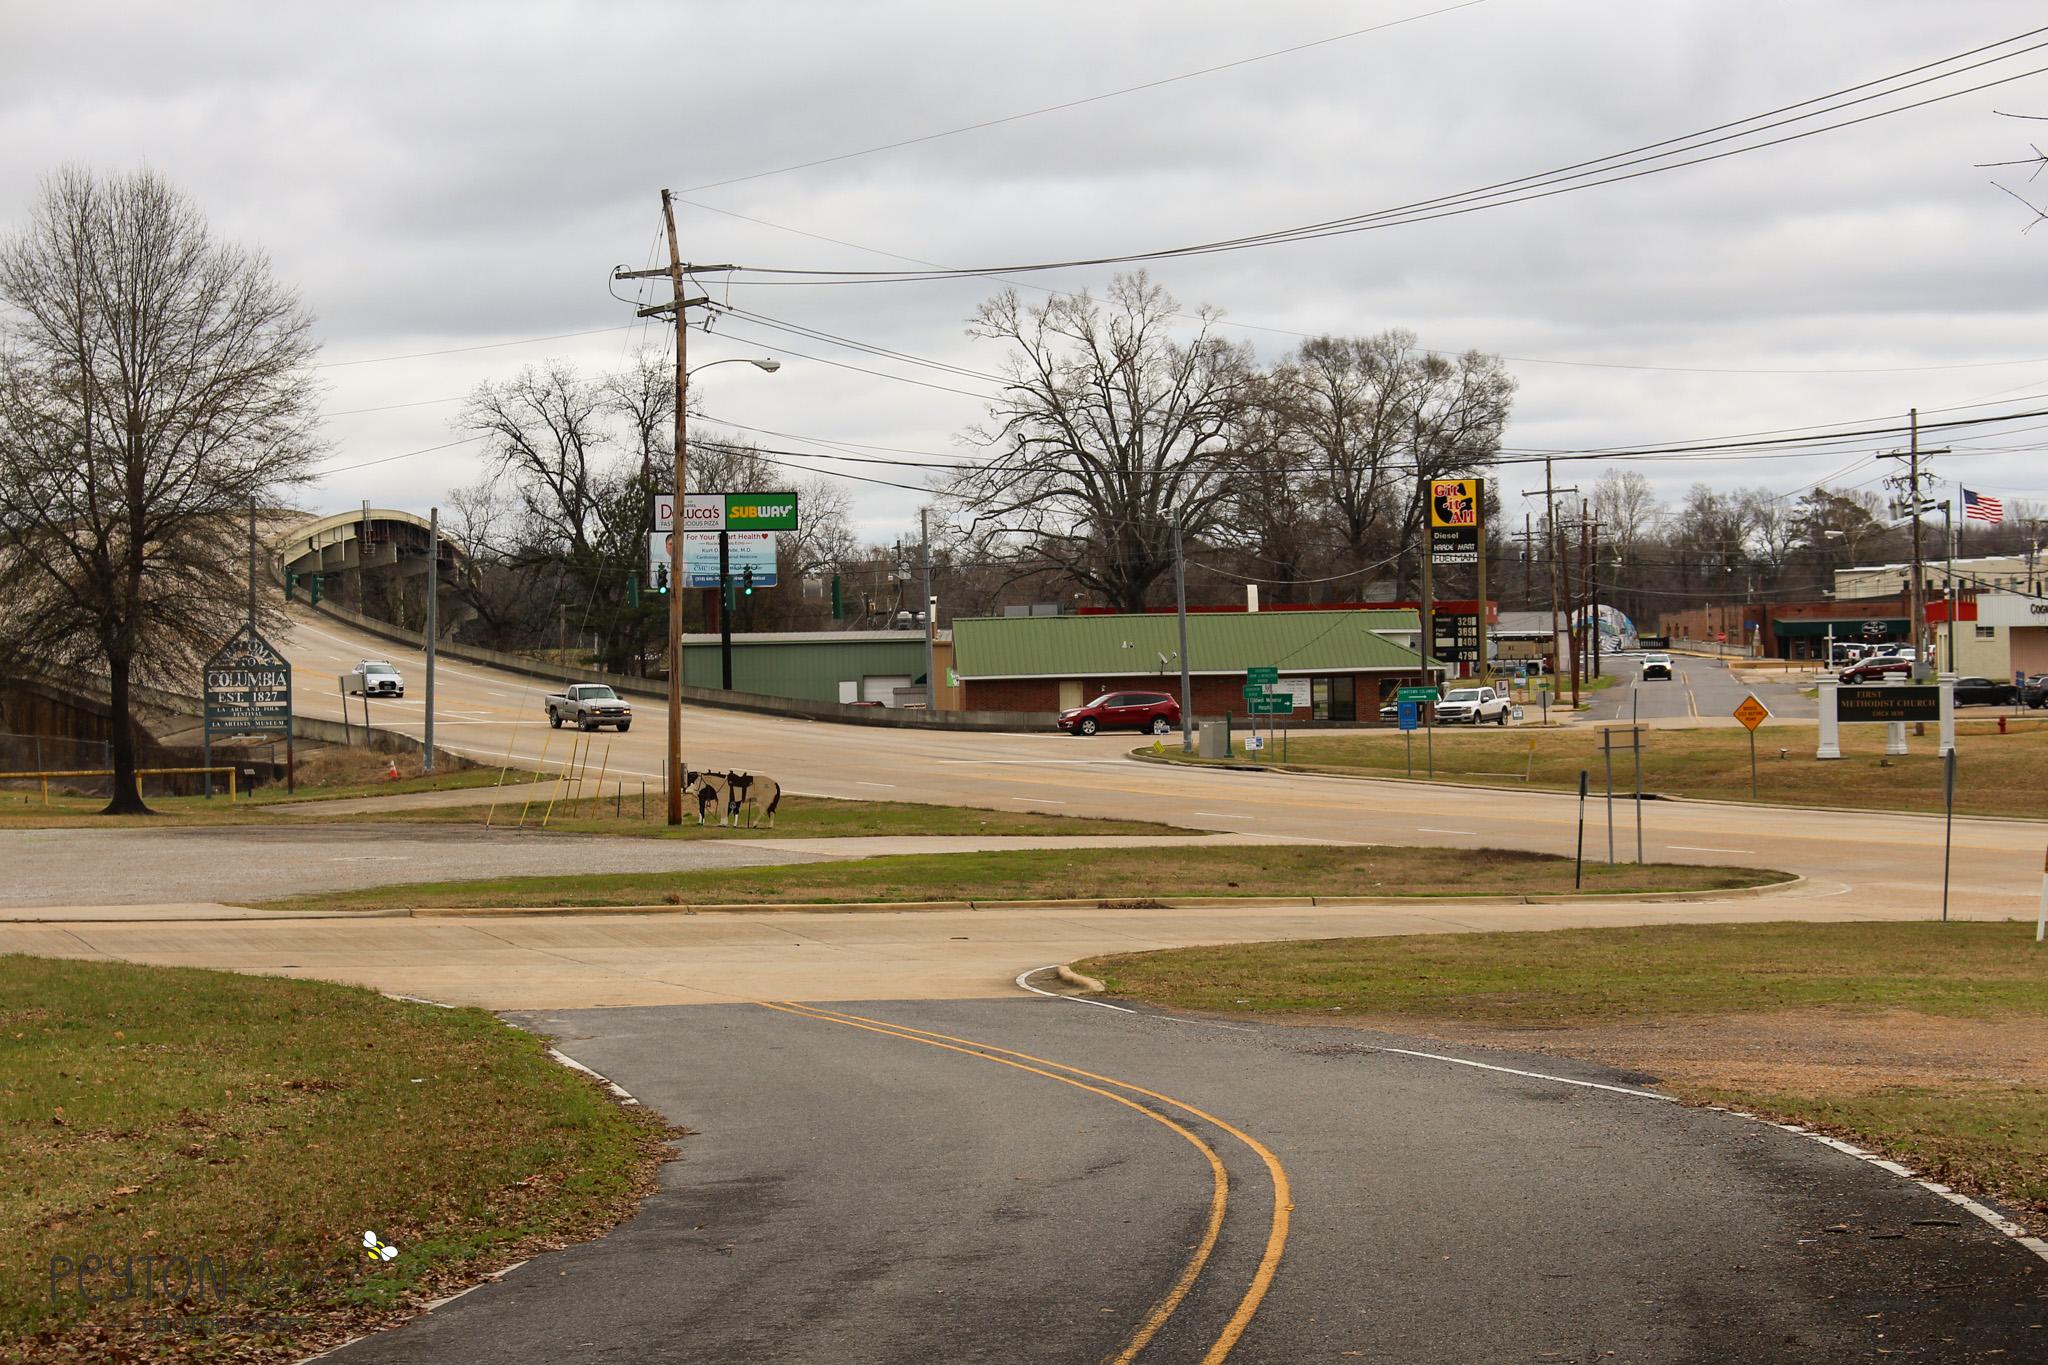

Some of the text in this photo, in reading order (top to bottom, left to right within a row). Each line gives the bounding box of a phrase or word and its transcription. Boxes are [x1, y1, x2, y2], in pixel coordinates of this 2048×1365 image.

[1434, 484, 1459, 497] Git
[729, 505, 793, 519] SUBWAY
[1450, 510, 1474, 524] All
[1457, 617, 1472, 626] 329
[1457, 627, 1472, 636] 369
[1458, 651, 1473, 660] 479
[208, 672, 287, 687] COLUMBIA
[218, 691, 278, 703] EST. 1827
